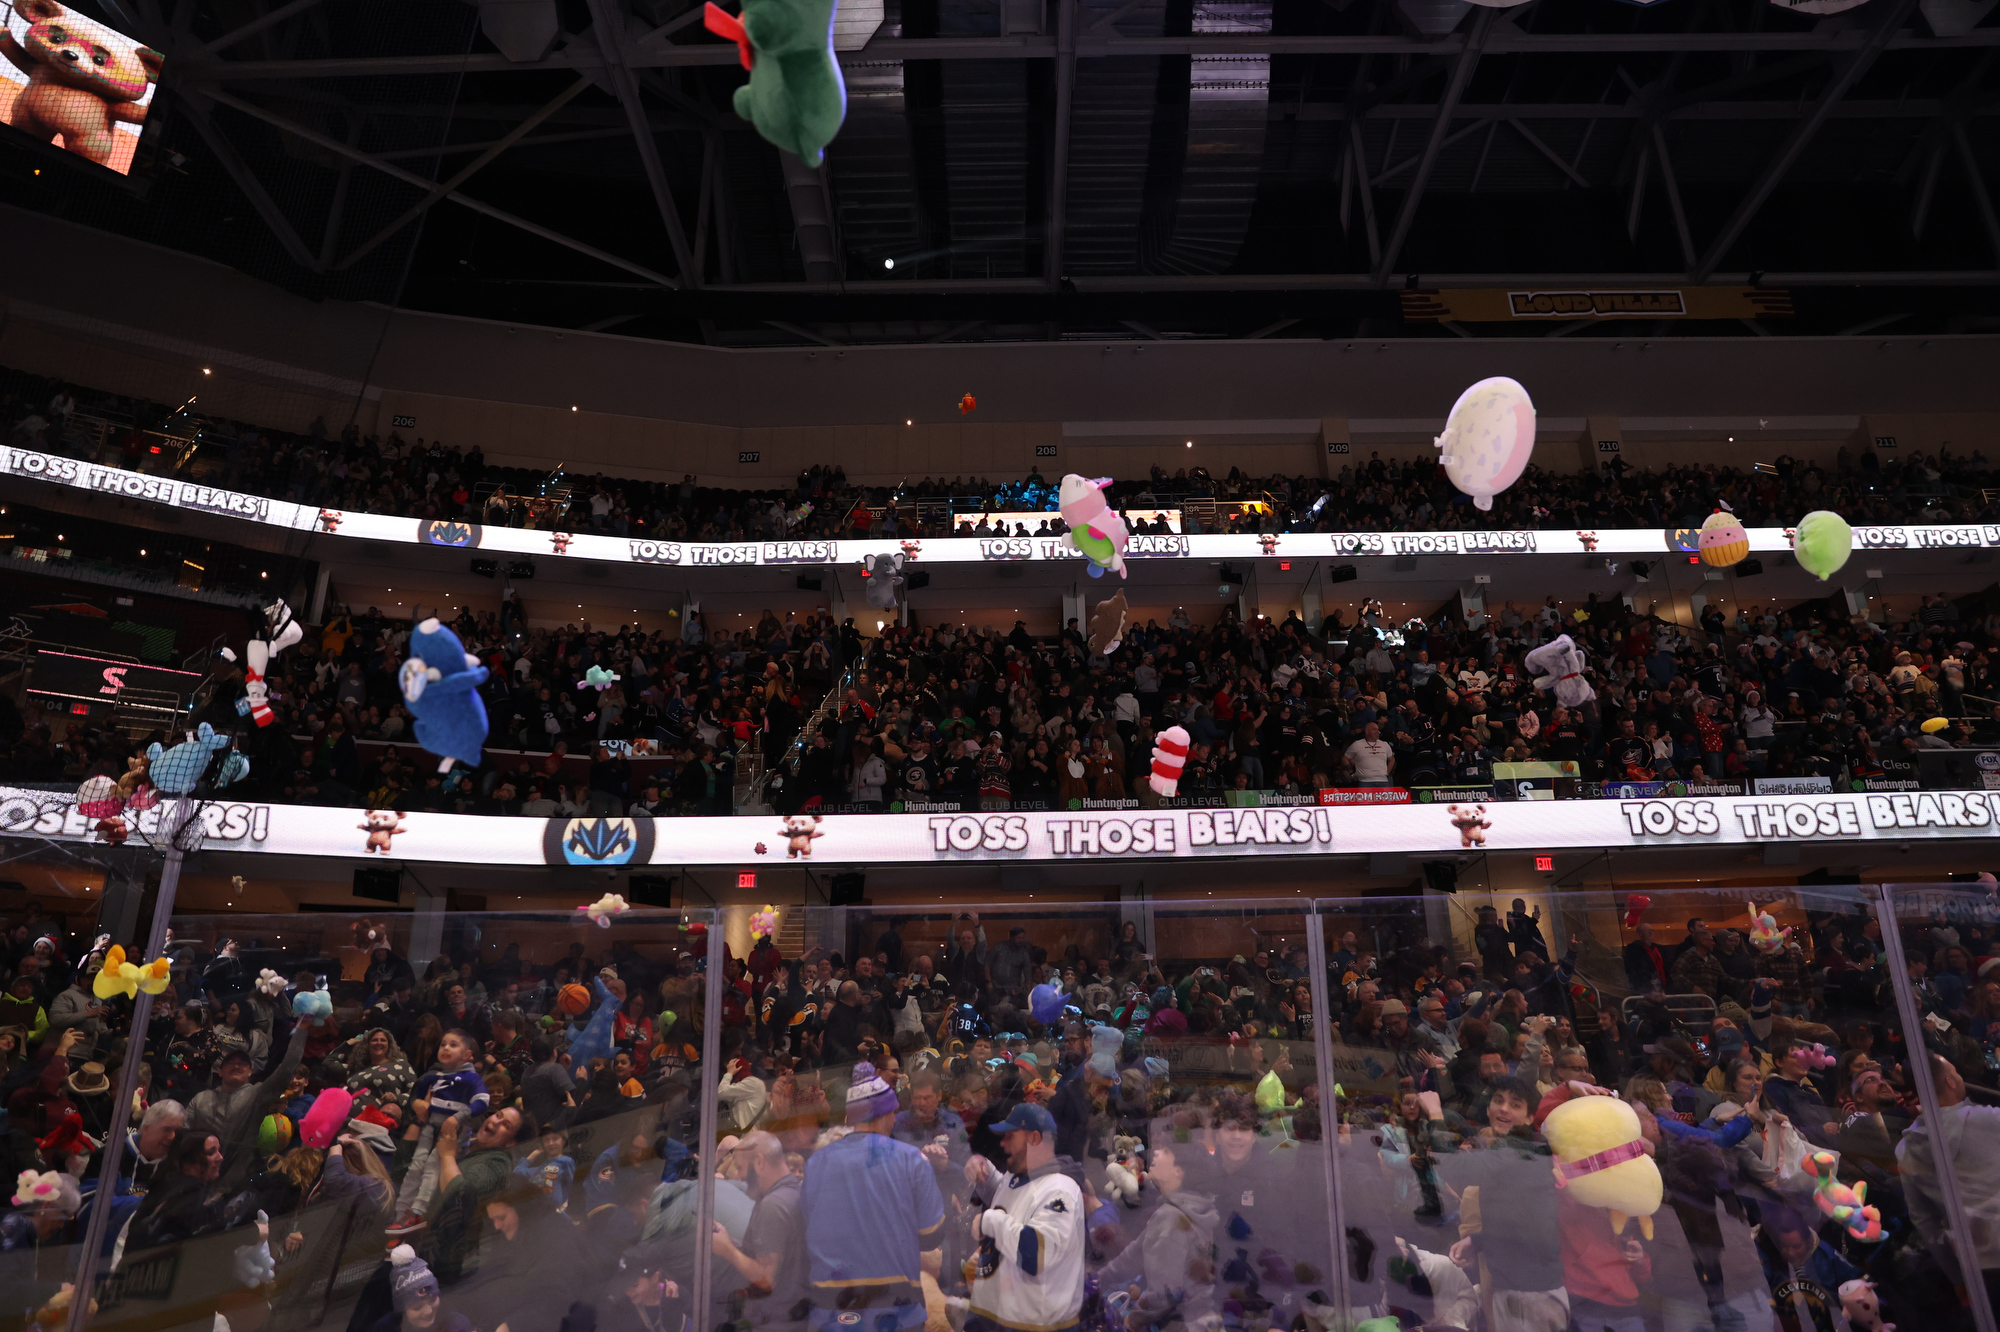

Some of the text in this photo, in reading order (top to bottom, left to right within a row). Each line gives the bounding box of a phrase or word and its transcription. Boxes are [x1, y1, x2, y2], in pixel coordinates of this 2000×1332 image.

[393, 416, 415, 427] 206
[163, 438, 184, 449] 206
[1329, 443, 1349, 453] 209
[1600, 442, 1619, 451] 210
[1877, 438, 1896, 447] 211
[740, 452, 759, 462] 207
[1036, 446, 1057, 456] 208
[11, 450, 269, 521] TOSS THOSE BEARS!
[1331, 532, 1537, 554] TOSS THOSE BEARS!
[1858, 528, 1908, 547] TOSS
[1914, 529, 1982, 546] THOSE
[630, 541, 838, 564] TOSS THOSE BEARS!
[979, 539, 1032, 559] TOSS
[1123, 536, 1190, 556] EARS!
[1981, 755, 1998, 763] FOX
[1686, 783, 1742, 796] Huntington
[1864, 778, 1921, 792] Huntington
[1433, 790, 1489, 802] Huntington
[1592, 787, 1621, 797] CLUB
[980, 800, 1049, 811] CLUB LEVEL
[1082, 797, 1139, 810] Huntington
[1158, 796, 1226, 807] CLUB LEVEL
[1259, 793, 1316, 806] Huntington
[804, 803, 872, 813] CLUB LEVEL
[904, 801, 961, 813] Huntington
[1622, 793, 2000, 837] TOSS THOSE BEARS!
[929, 809, 1333, 854] TOSS THOSE BEARS!
[1535, 857, 1553, 871] EXIT
[738, 873, 756, 888] EXIT
[958, 1019, 972, 1031] 38
[1778, 1281, 1826, 1300] CLEVELAND
